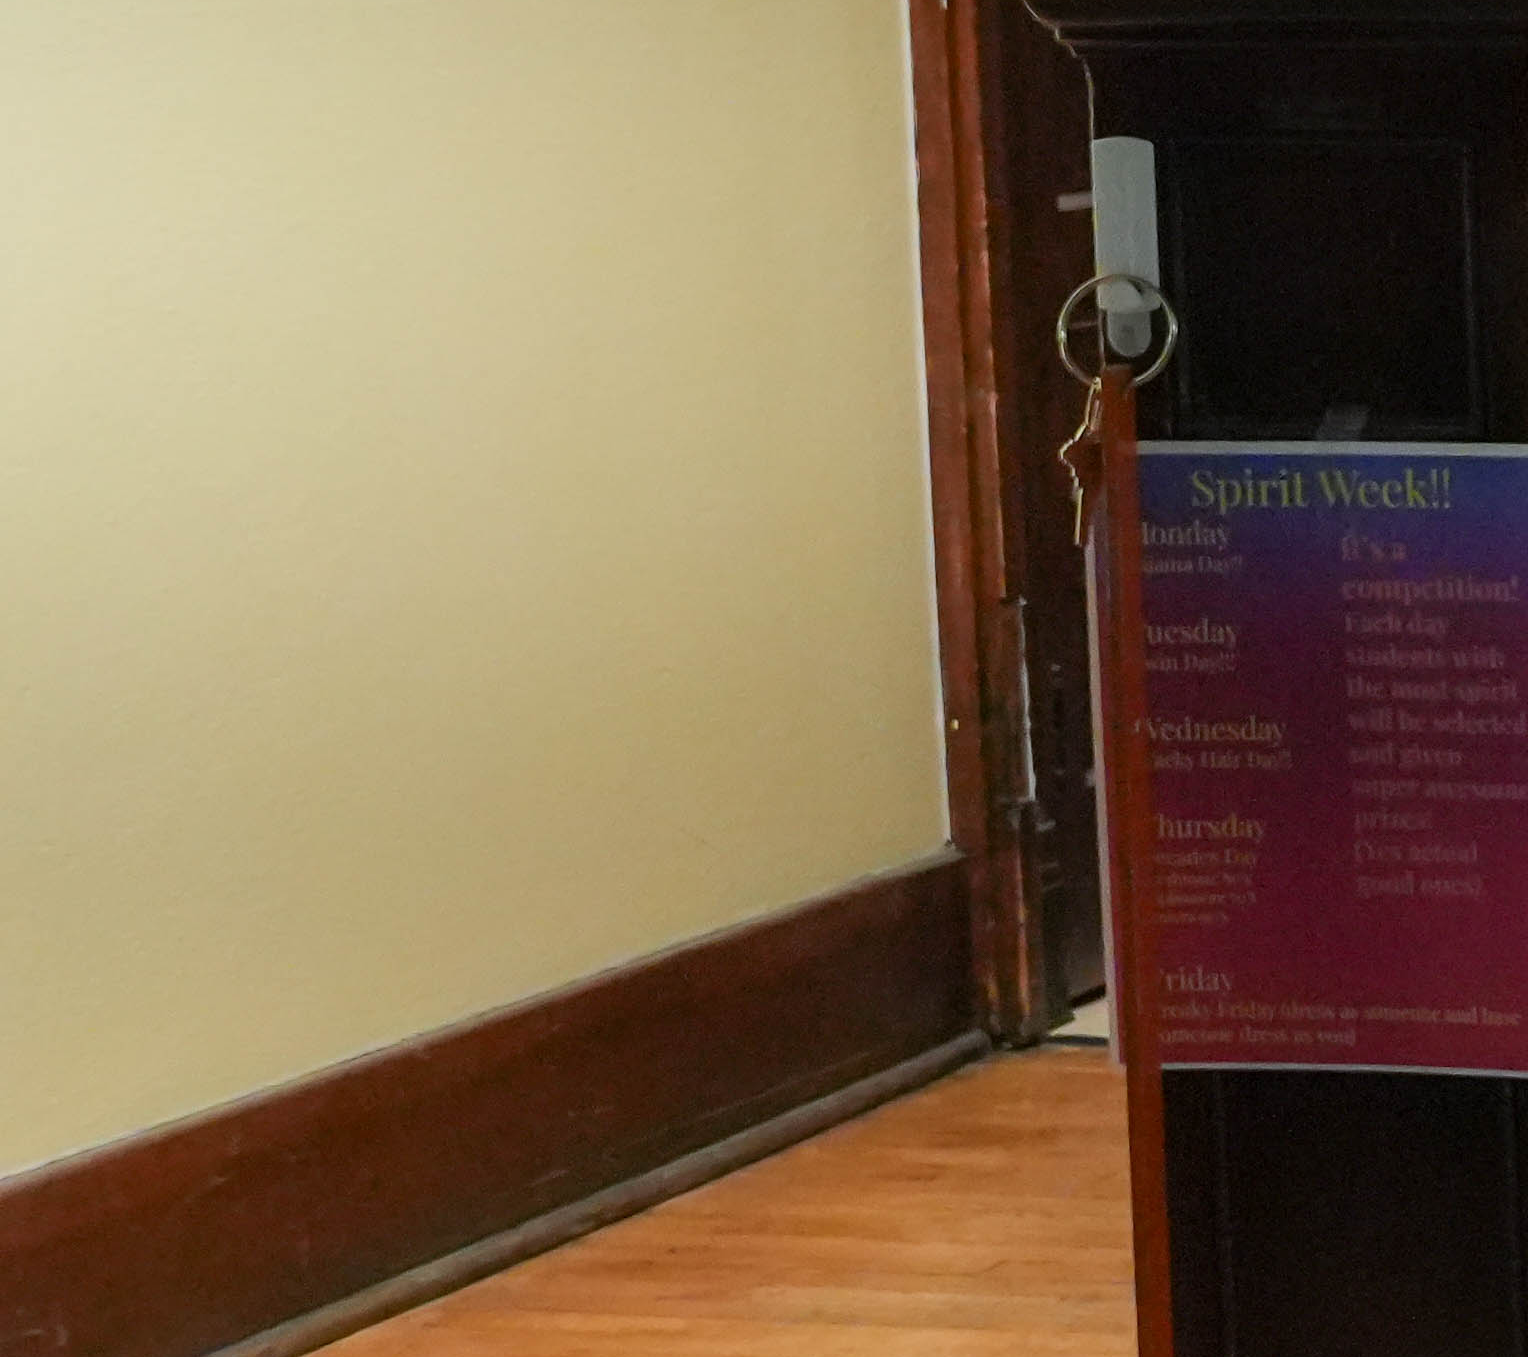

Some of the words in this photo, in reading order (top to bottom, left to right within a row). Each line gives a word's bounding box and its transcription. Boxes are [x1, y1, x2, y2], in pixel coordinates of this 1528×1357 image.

[1191, 468, 1311, 515] Spirit
[1319, 468, 1452, 509] Week!!
[1141, 519, 1229, 551] onday
[1341, 574, 1519, 606] competition!
[1145, 617, 1239, 650] uesday
[1406, 611, 1448, 640] day
[1145, 655, 1178, 672] win
[1345, 643, 1446, 667] students
[1452, 645, 1506, 668] with
[1346, 675, 1385, 698] the
[1454, 678, 1518, 704] spirit
[1347, 708, 1393, 732] will
[1398, 708, 1423, 732] be
[1432, 710, 1528, 735] selected
[1152, 752, 1194, 771] acky
[1349, 742, 1393, 764] and
[1398, 743, 1462, 770] given
[1156, 812, 1265, 844] hursday
[1159, 964, 1232, 994] riday
[1160, 1001, 1212, 1022] reaky
[1158, 1027, 1233, 1044] omeone
